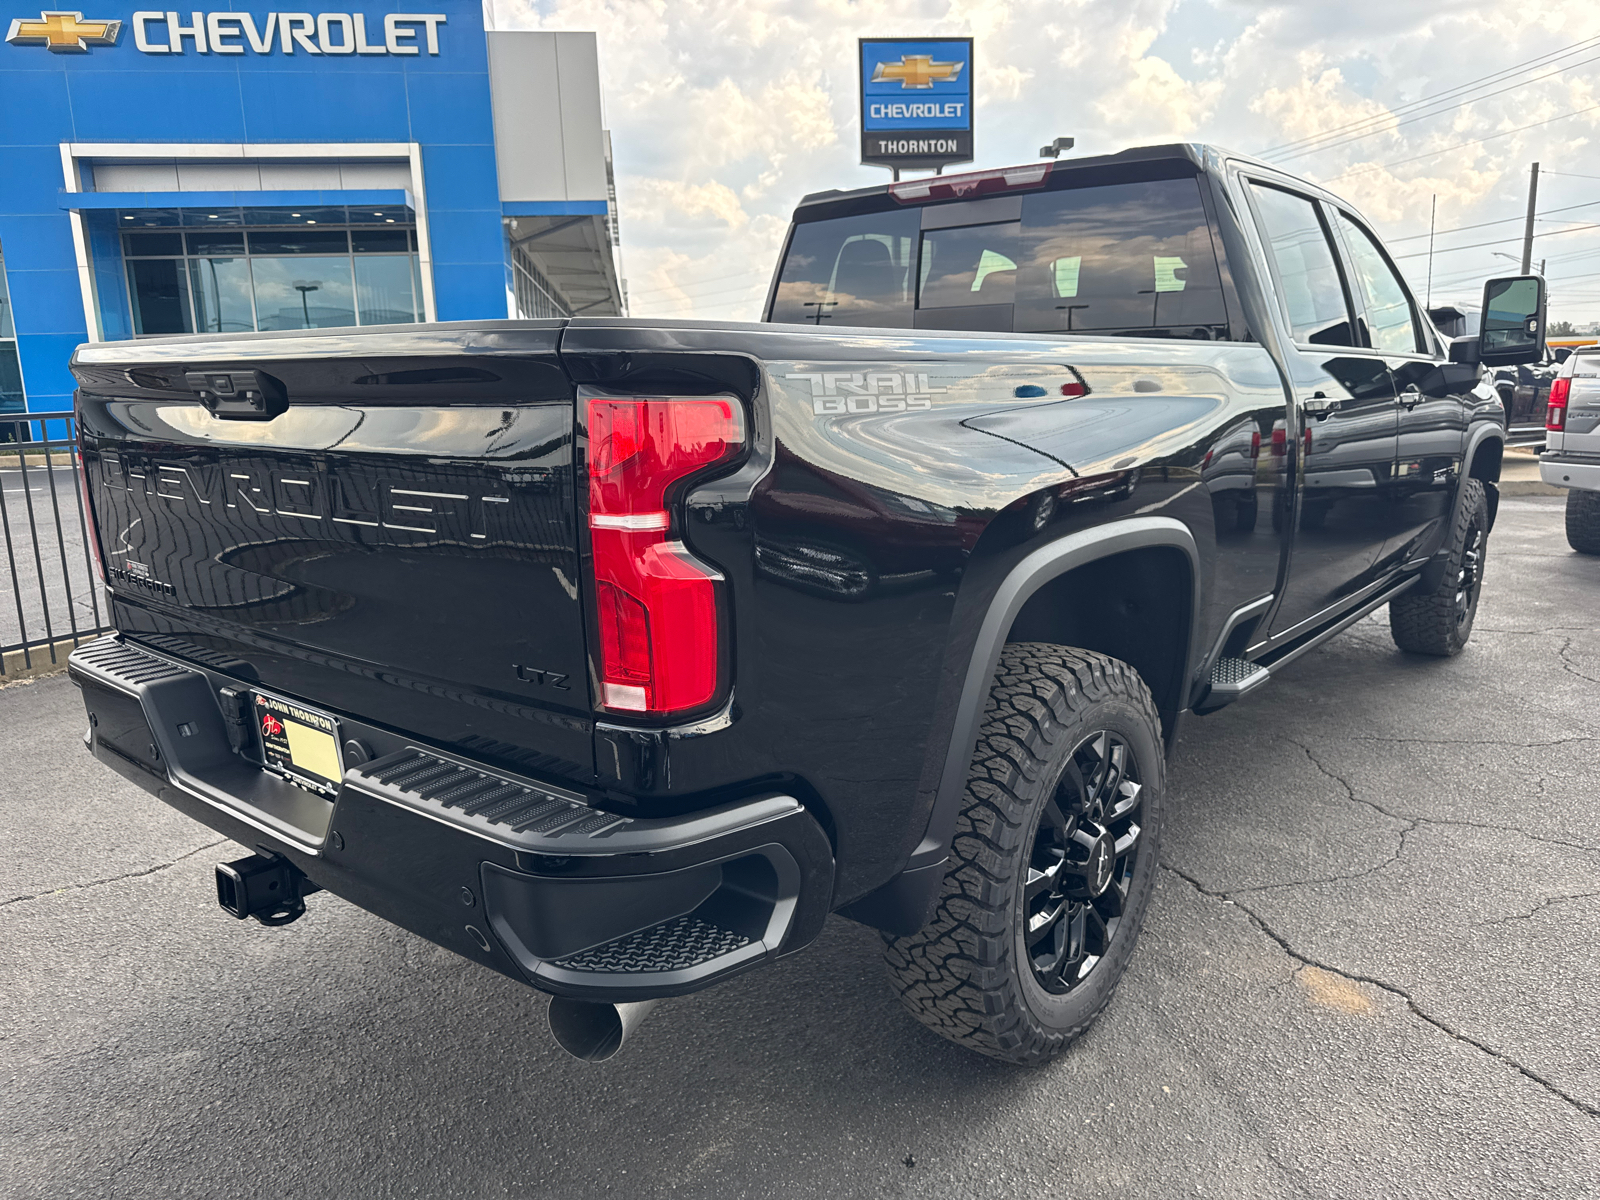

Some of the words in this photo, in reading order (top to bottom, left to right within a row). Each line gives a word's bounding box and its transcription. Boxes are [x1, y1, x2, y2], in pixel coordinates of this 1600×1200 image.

[133, 11, 446, 55] CHEVROLET
[870, 103, 964, 118] CHEVROLET
[878, 139, 957, 153] THORNTON
[785, 372, 947, 395] TRAIL
[813, 394, 932, 416] BOSS
[99, 451, 511, 539] CHEVROLET
[108, 565, 177, 597] SILVERADO
[511, 663, 572, 691] LTZ
[268, 699, 289, 714] JOHN
[289, 707, 332, 731] THORNTON
